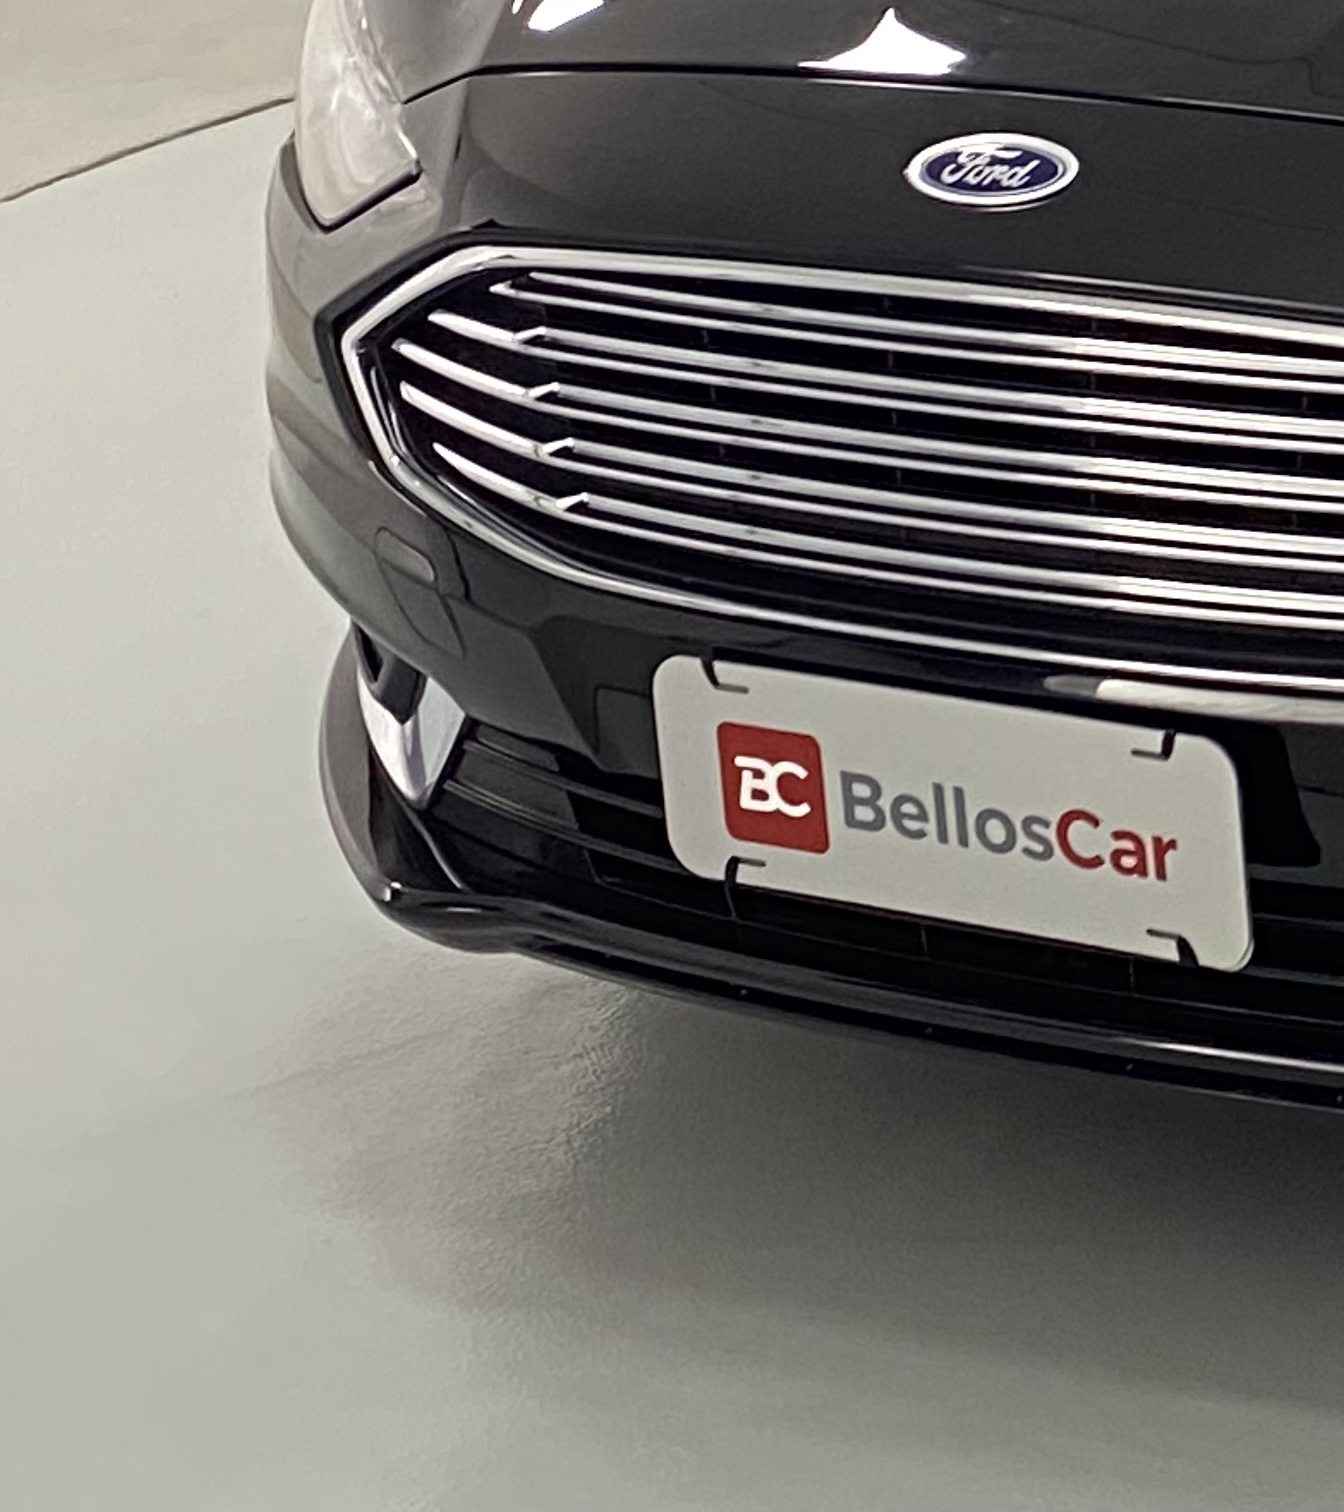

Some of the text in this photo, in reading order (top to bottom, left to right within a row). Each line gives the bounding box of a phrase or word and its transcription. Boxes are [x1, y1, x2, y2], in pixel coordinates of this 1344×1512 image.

[940, 145, 1041, 187] Ford
[734, 755, 1177, 882] BC BellosCar
